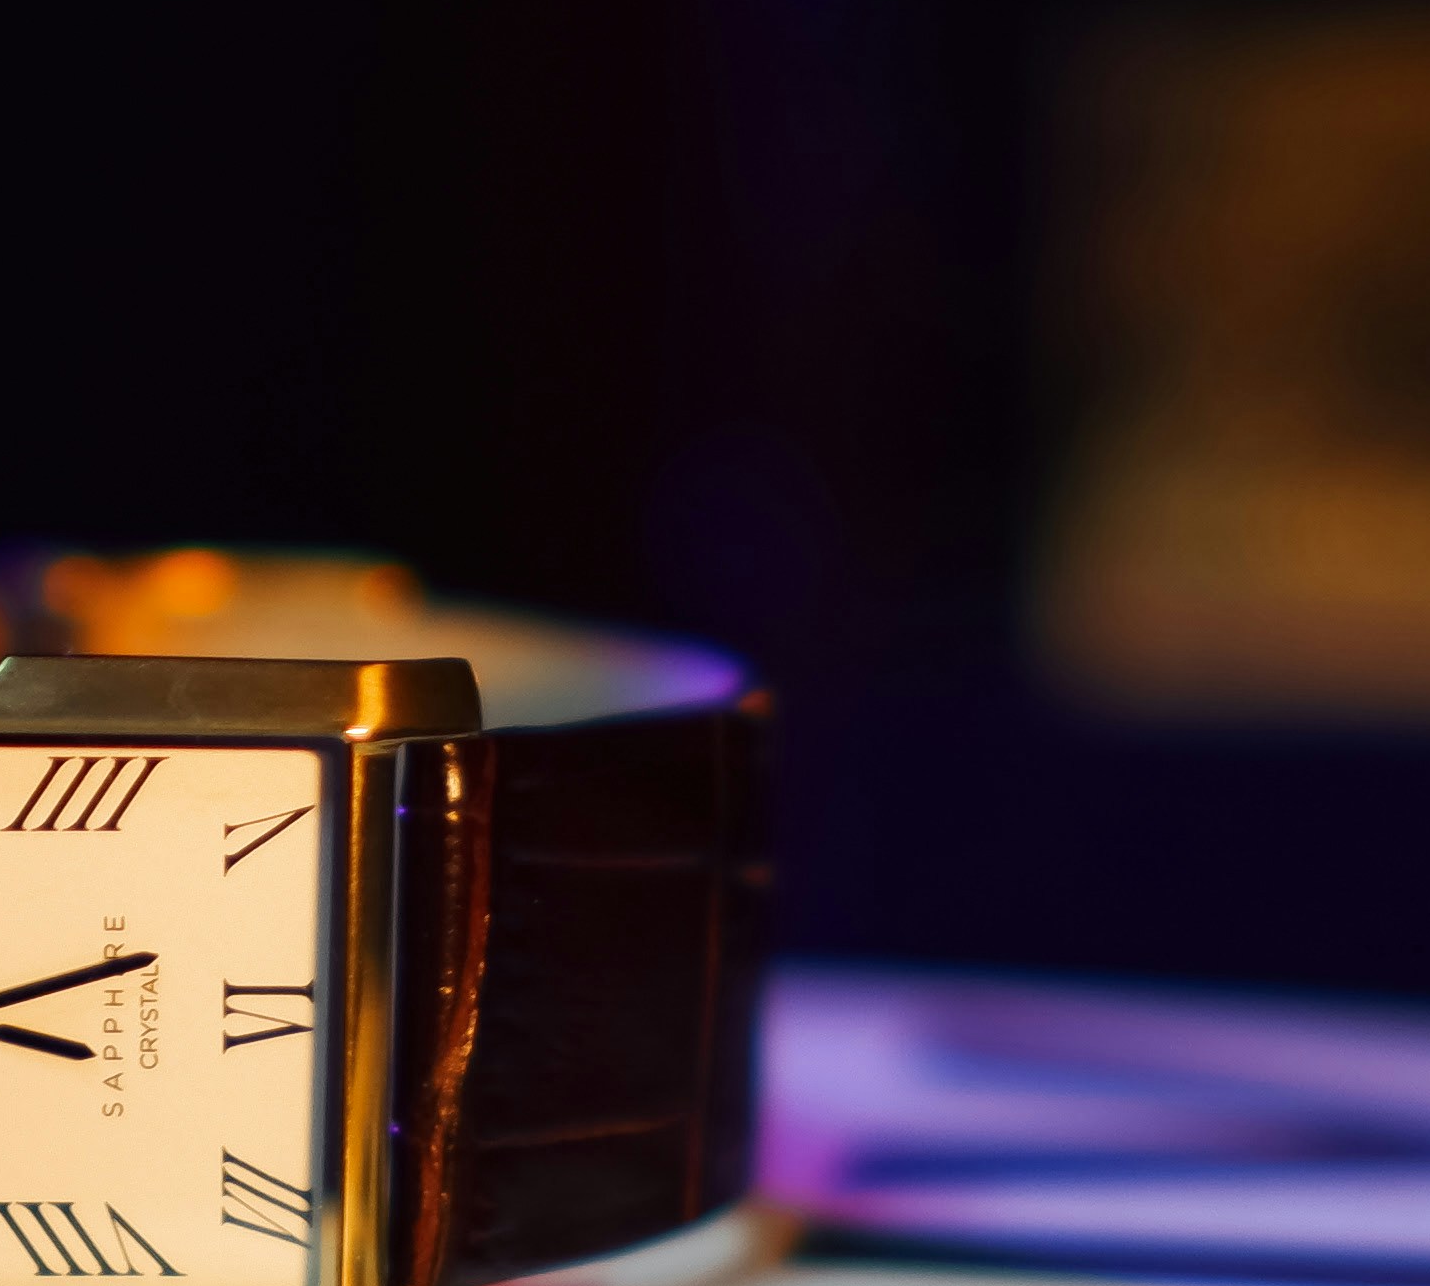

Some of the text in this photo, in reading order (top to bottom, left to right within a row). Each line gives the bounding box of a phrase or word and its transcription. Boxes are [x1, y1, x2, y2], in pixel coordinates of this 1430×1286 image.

[223, 804, 317, 878] V
[101, 915, 126, 1118] SAPPHRE
[138, 963, 159, 1070] CRYSTAL
[223, 977, 316, 1055] VI
[221, 1145, 314, 1249] VII
